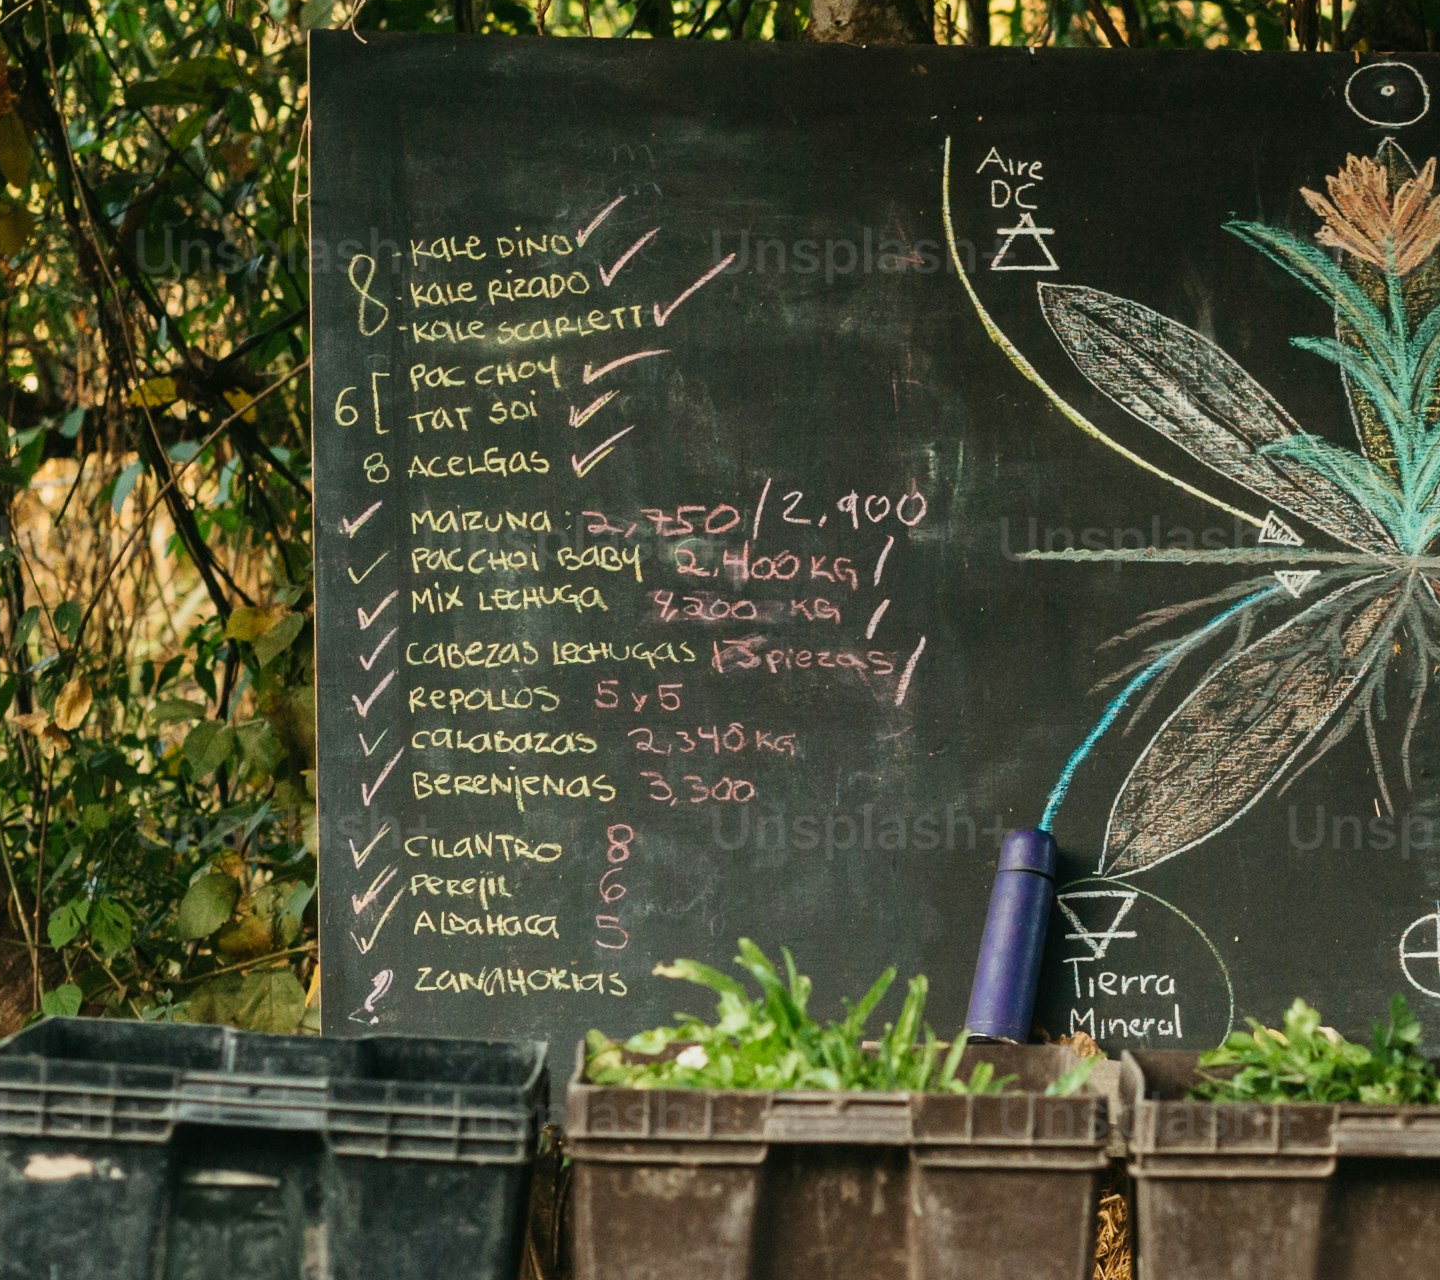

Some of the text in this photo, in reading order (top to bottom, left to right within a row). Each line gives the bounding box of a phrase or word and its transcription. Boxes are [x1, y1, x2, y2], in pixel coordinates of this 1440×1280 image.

[976, 147, 1043, 180] Aire
[348, 254, 389, 336] 8
[335, 387, 358, 426] 6
[364, 452, 390, 483] 8
[595, 680, 618, 708] 5
[658, 684, 683, 710] 5
[607, 824, 634, 863] 8
[599, 867, 626, 903] 6
[595, 915, 628, 949] 5
[1062, 957, 1175, 998] Tierra
[1070, 1004, 1182, 1040] Mineral
